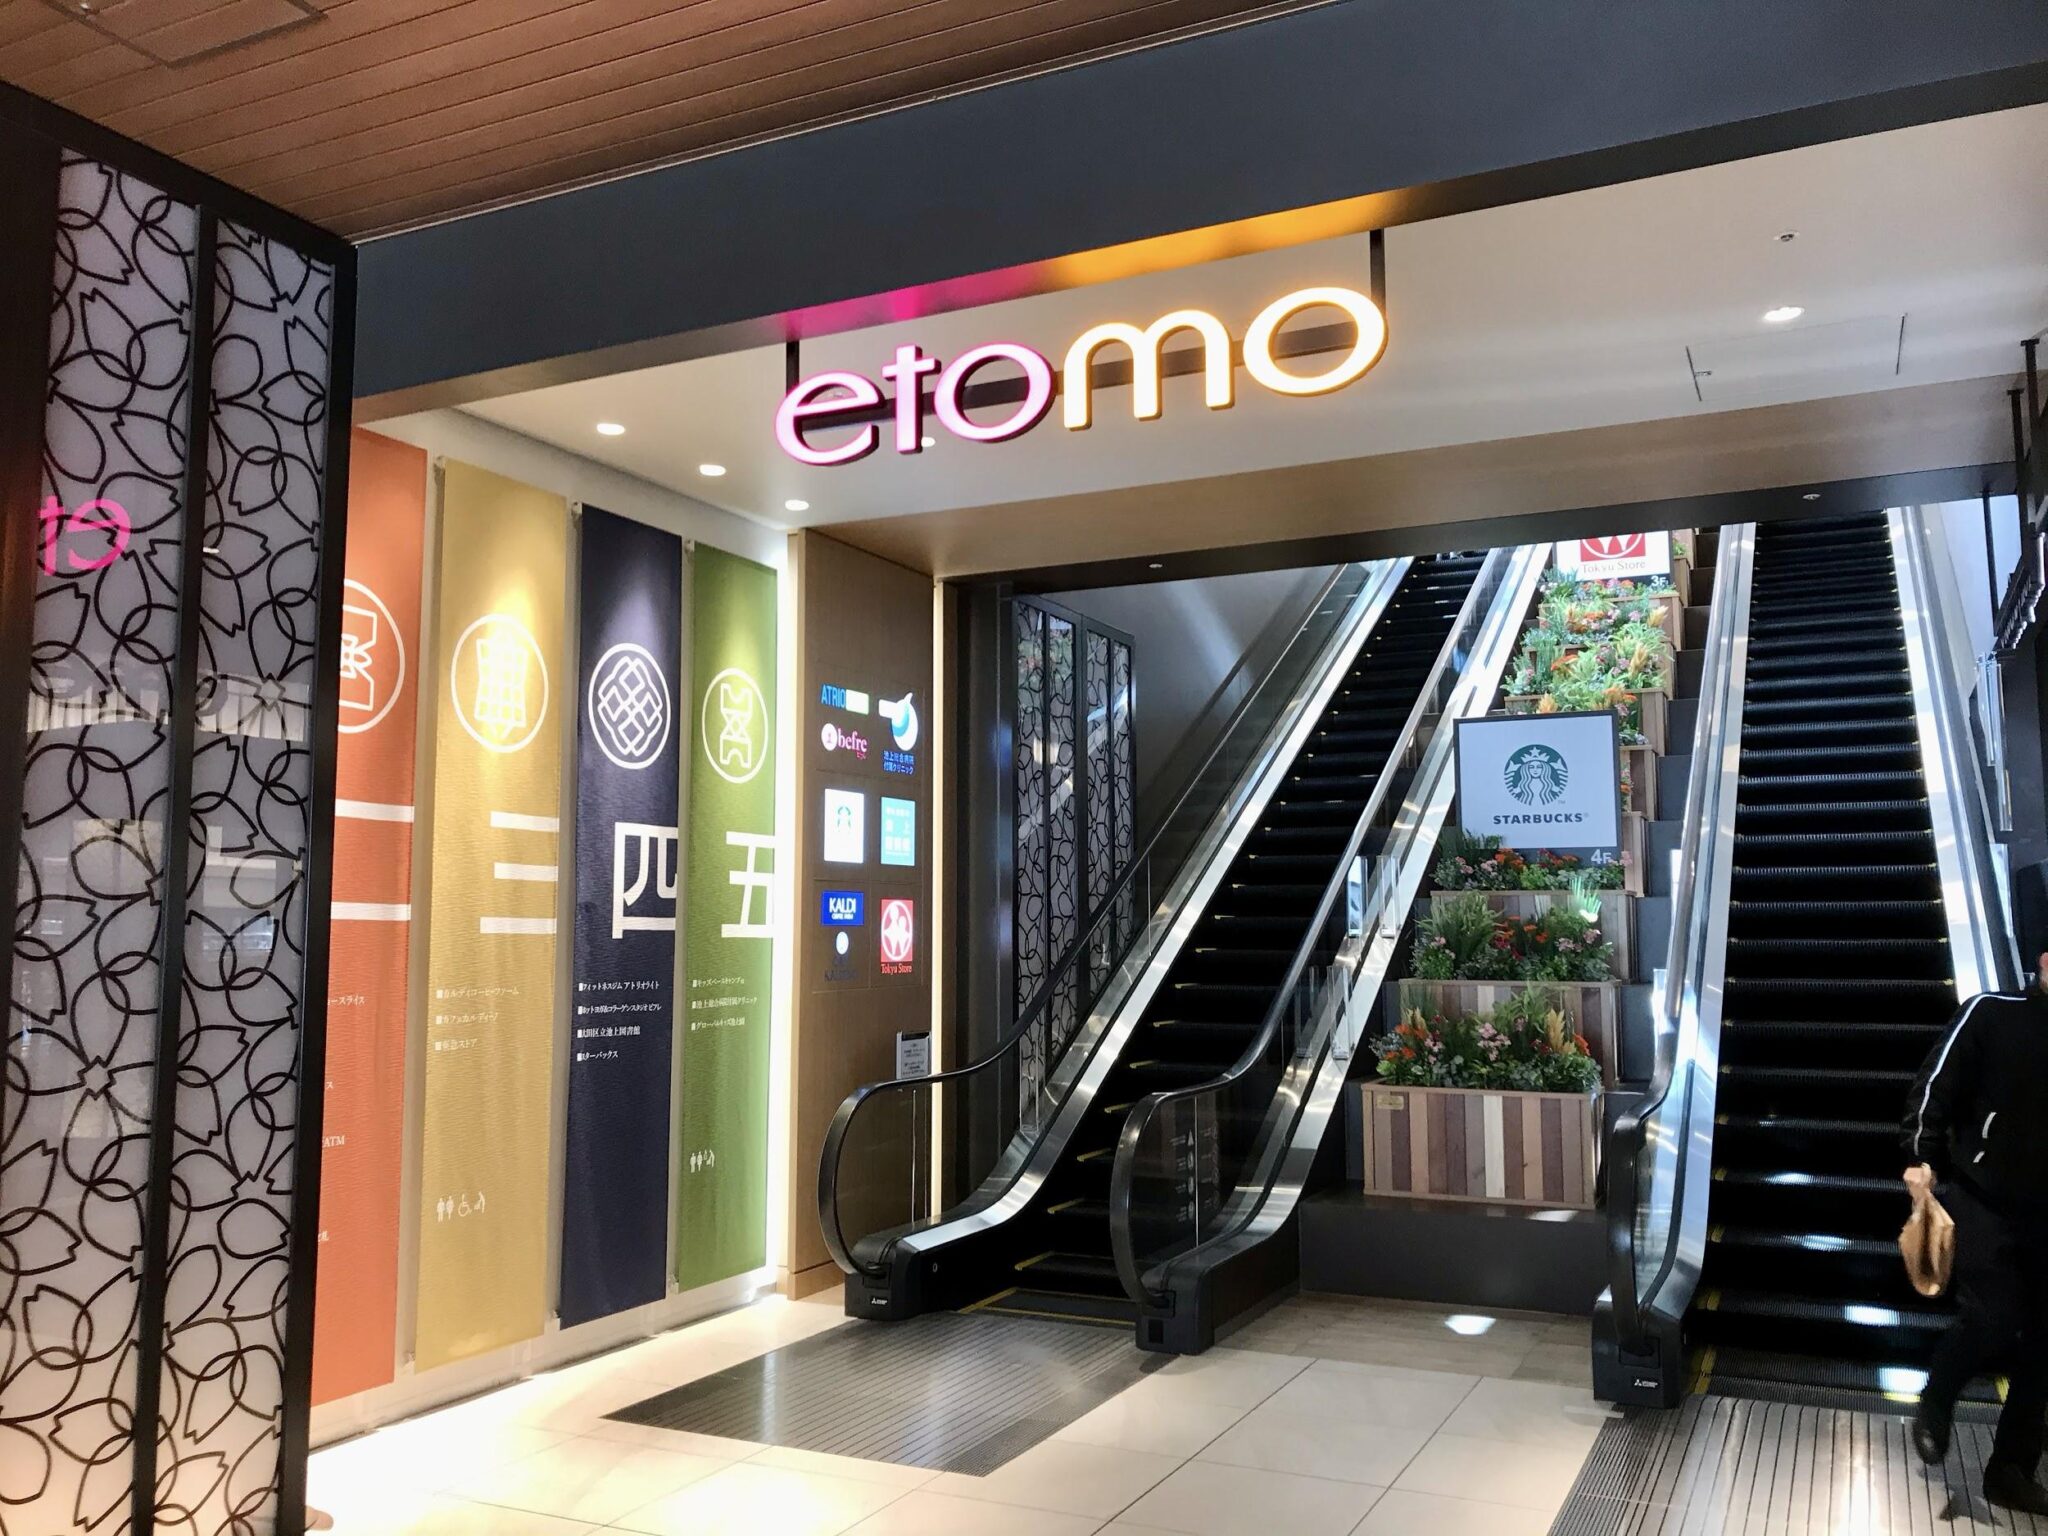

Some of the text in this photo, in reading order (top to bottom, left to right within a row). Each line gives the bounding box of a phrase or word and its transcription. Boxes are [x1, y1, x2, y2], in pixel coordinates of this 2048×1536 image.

[774, 286, 1388, 466] etomo
[1582, 560, 1646, 574] Tokyu Store
[821, 684, 846, 709] ATRIO
[1493, 812, 1583, 825] STARBUCKS
[1590, 849, 1612, 865] 4F
[480, 810, 559, 935] 三
[612, 822, 678, 940] 四
[829, 897, 857, 914] KALDI
[880, 963, 912, 975] Tokyu Store
